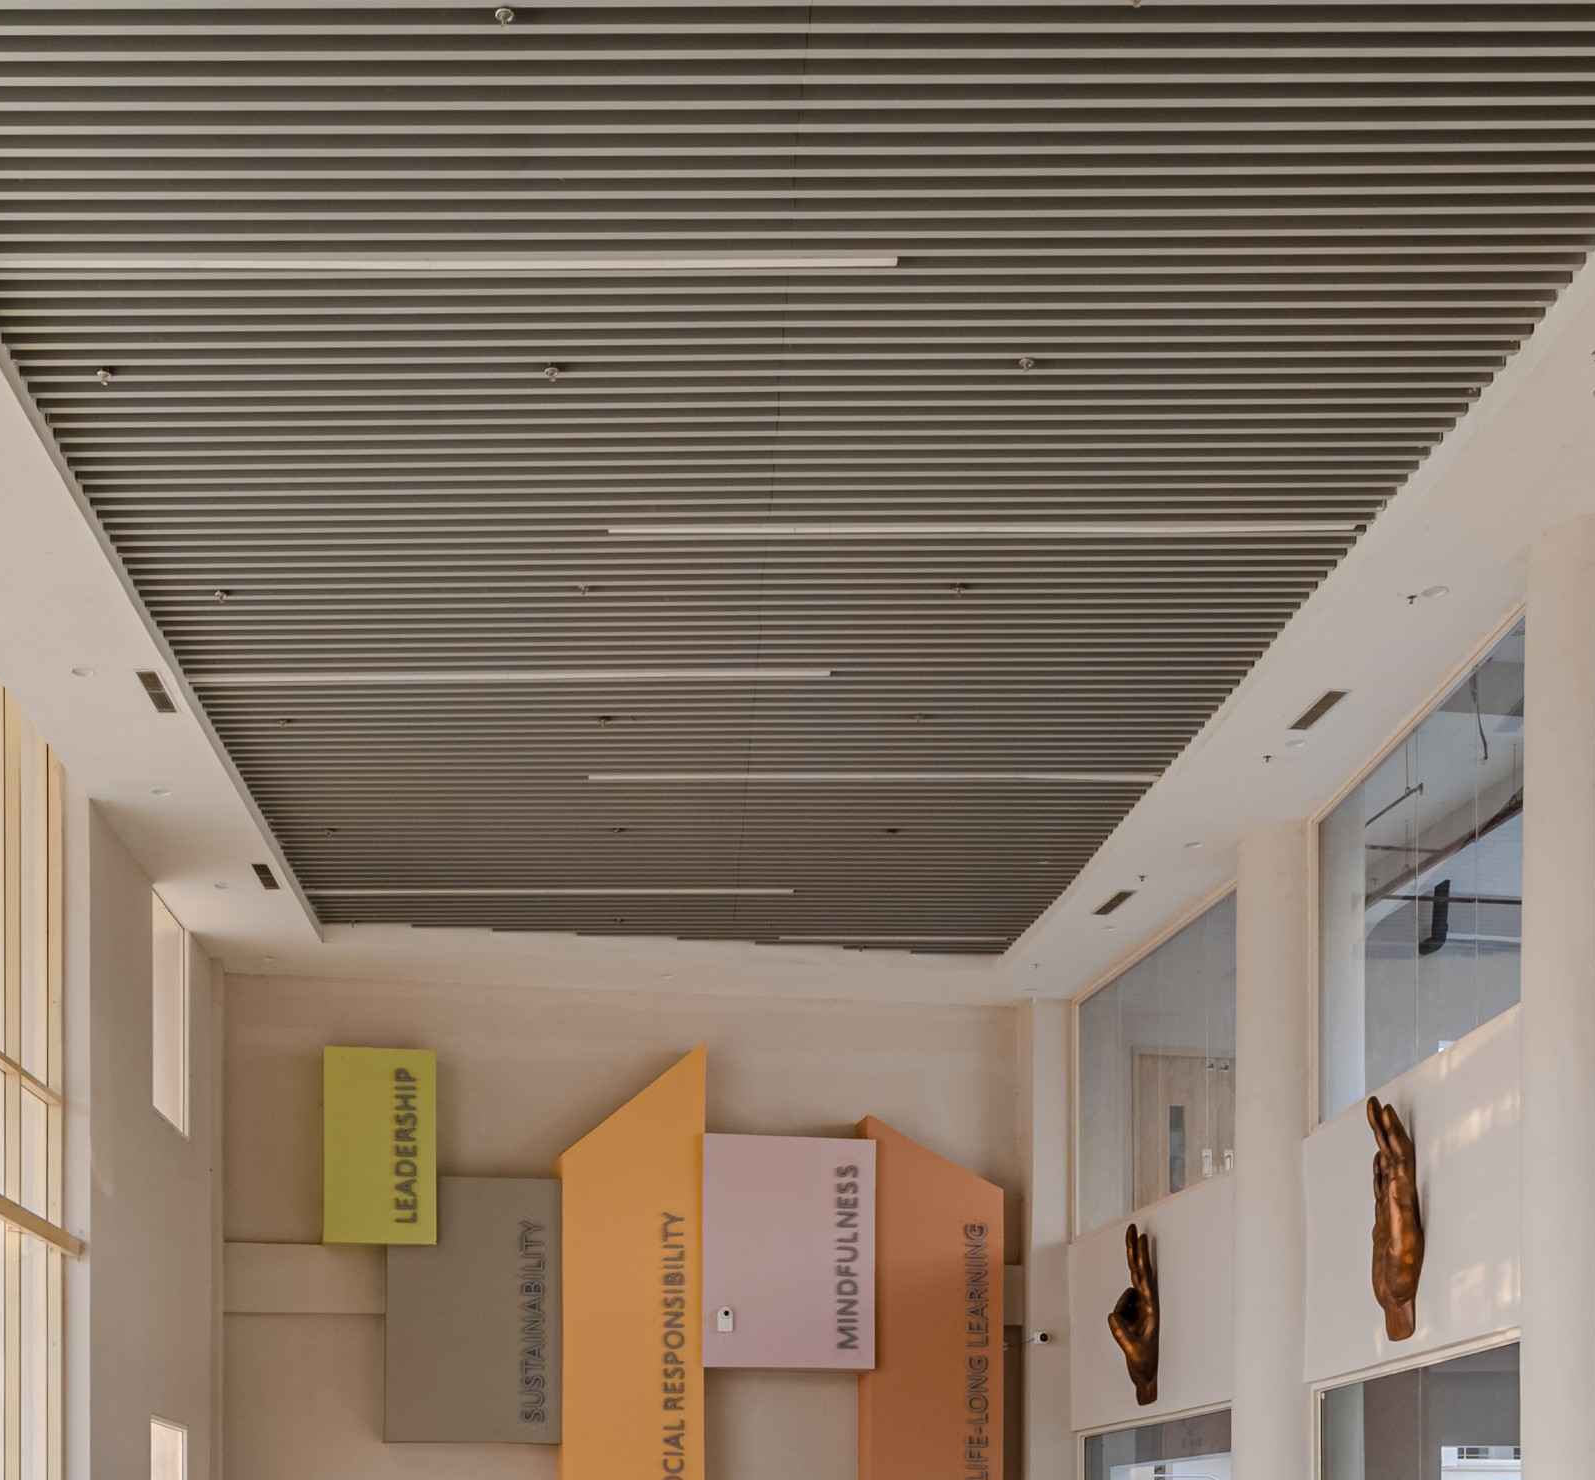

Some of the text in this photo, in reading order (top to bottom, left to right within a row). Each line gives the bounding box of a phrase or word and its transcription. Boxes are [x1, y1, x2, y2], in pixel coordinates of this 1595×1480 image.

[393, 1067, 417, 1224] LEADERSHIP
[521, 1219, 546, 1424] SUSTAINABILITY
[662, 1211, 685, 1411] RESPONSIBILITY
[835, 1163, 859, 1350] MINDFULNESS
[964, 1222, 989, 1348] LEARNING
